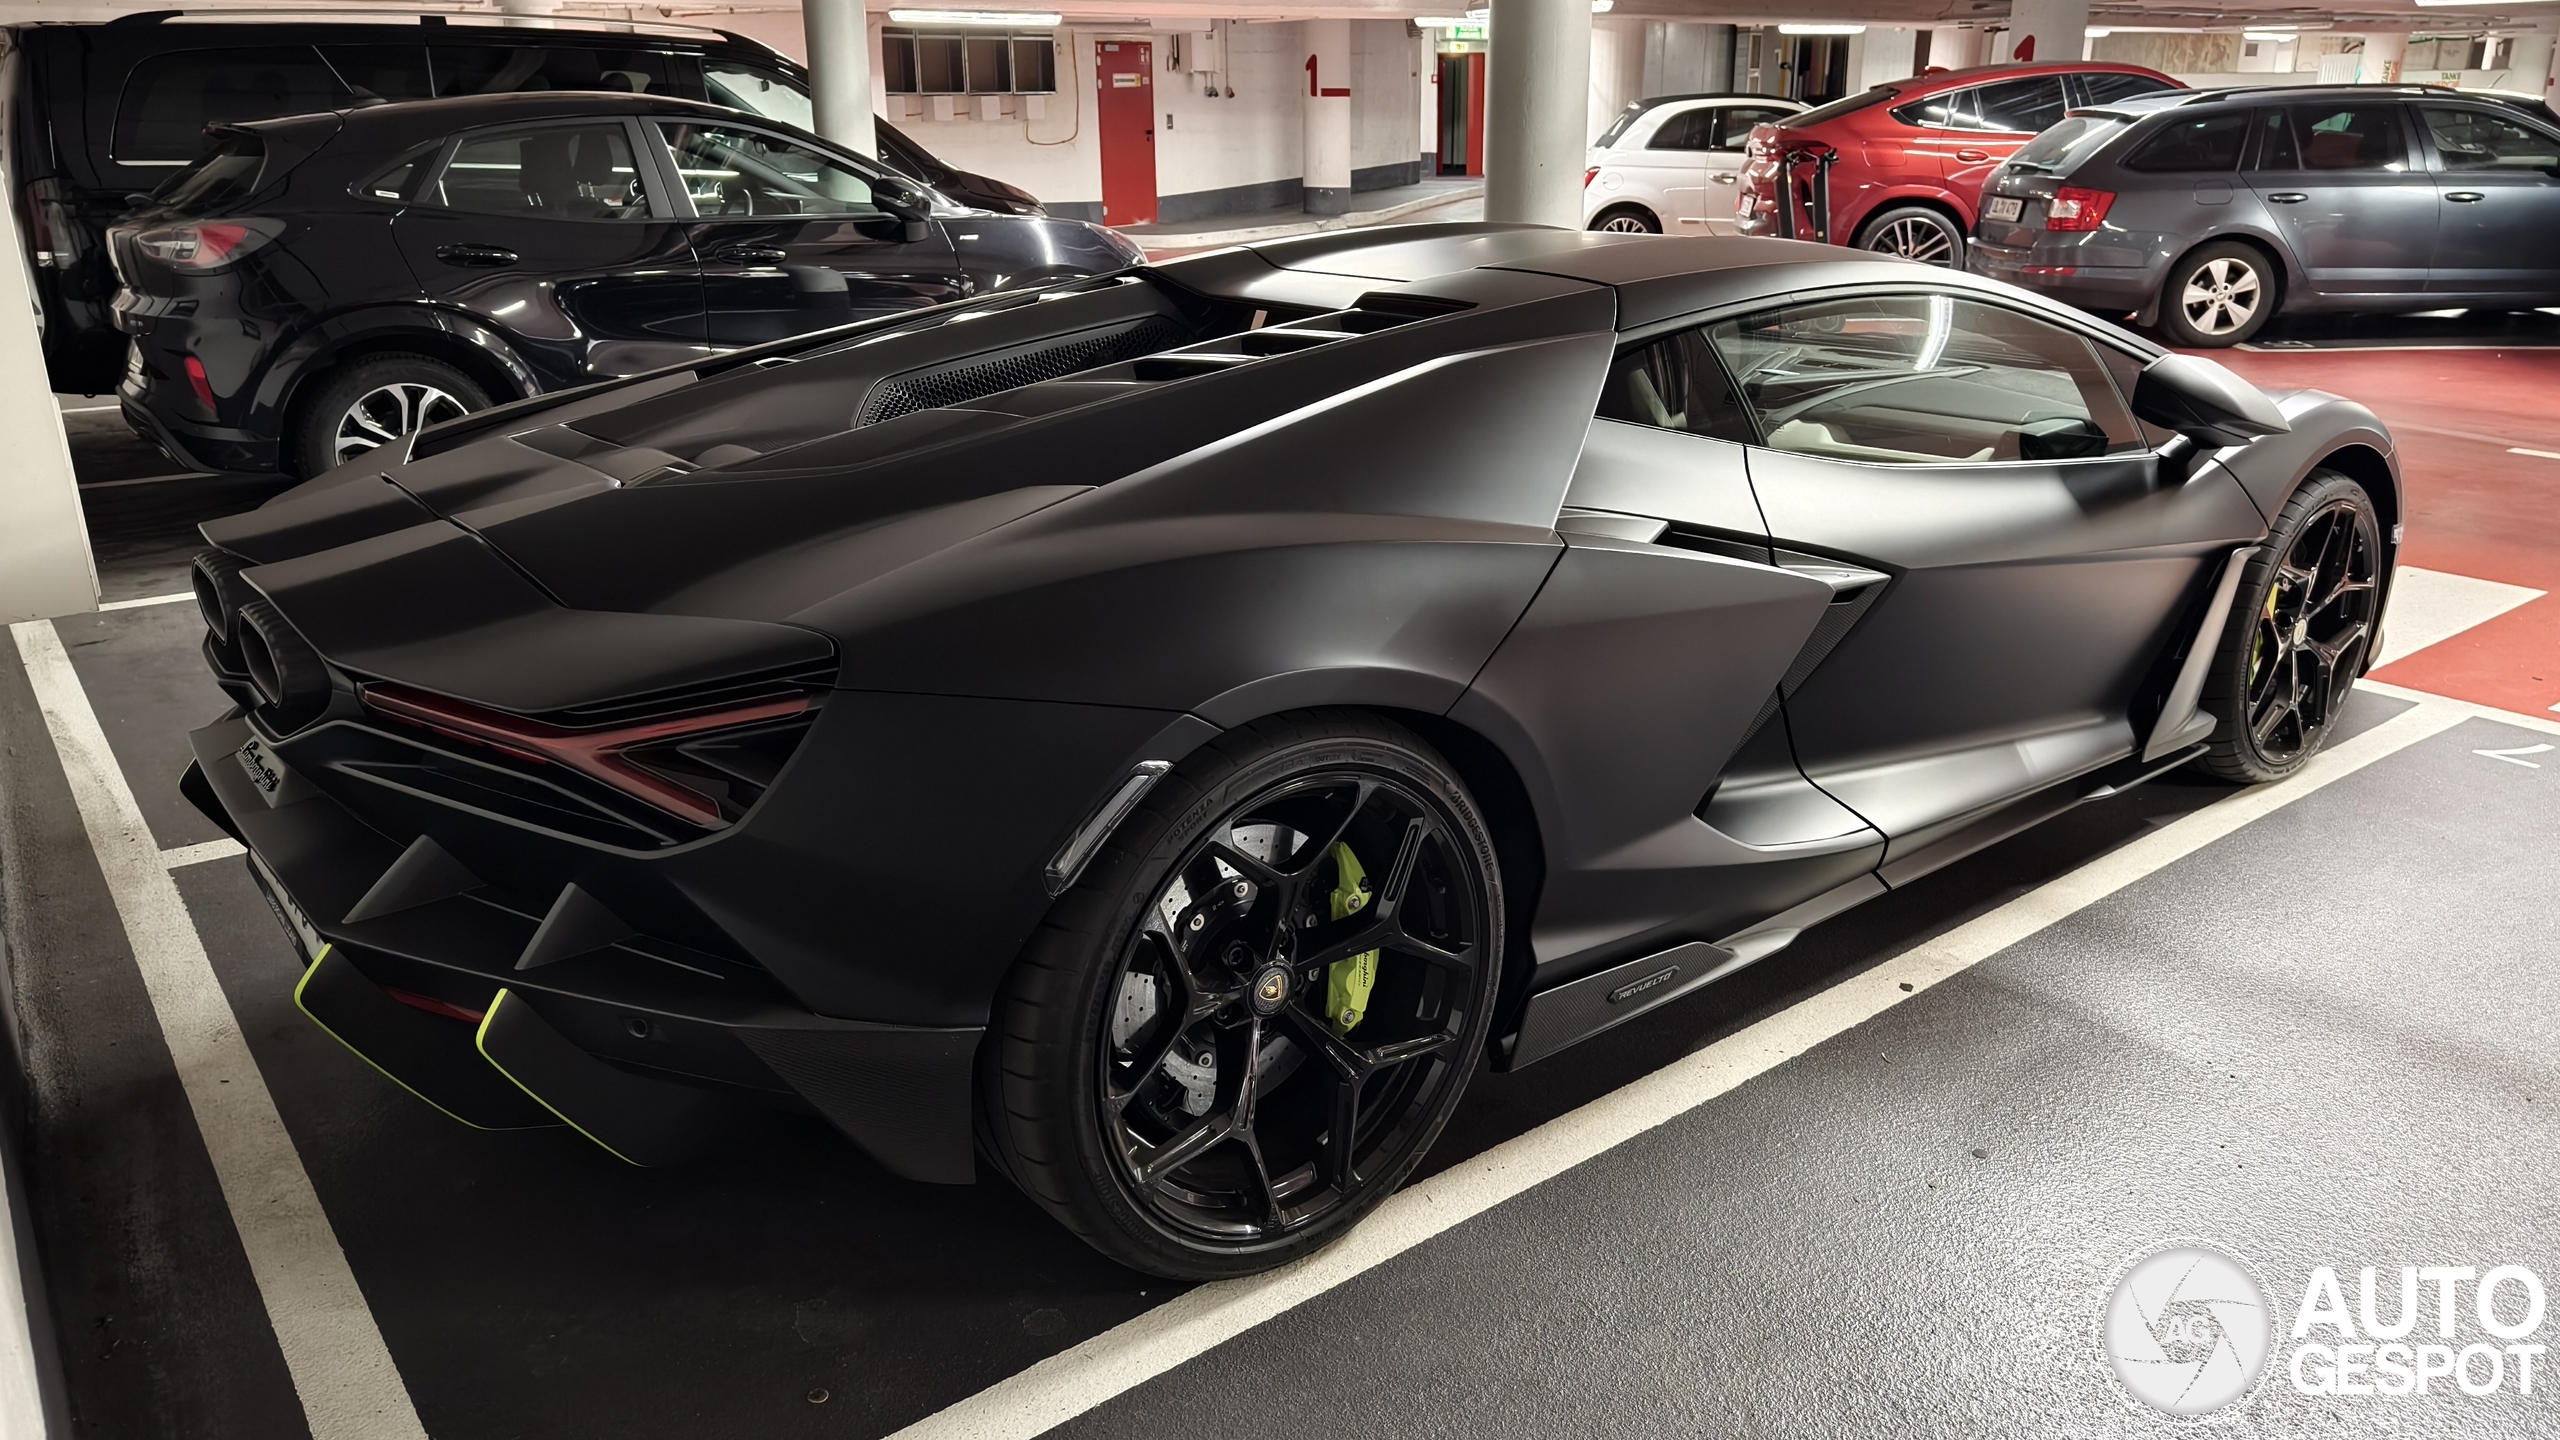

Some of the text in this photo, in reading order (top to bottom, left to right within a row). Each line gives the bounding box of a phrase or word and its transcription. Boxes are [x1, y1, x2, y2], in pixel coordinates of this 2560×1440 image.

[1167, 798, 1214, 845] POTENZA
[1450, 790, 1495, 871] BRIDGESTONE
[1362, 951, 1370, 988] borghini
[1619, 970, 1673, 1000] REVUELTO
